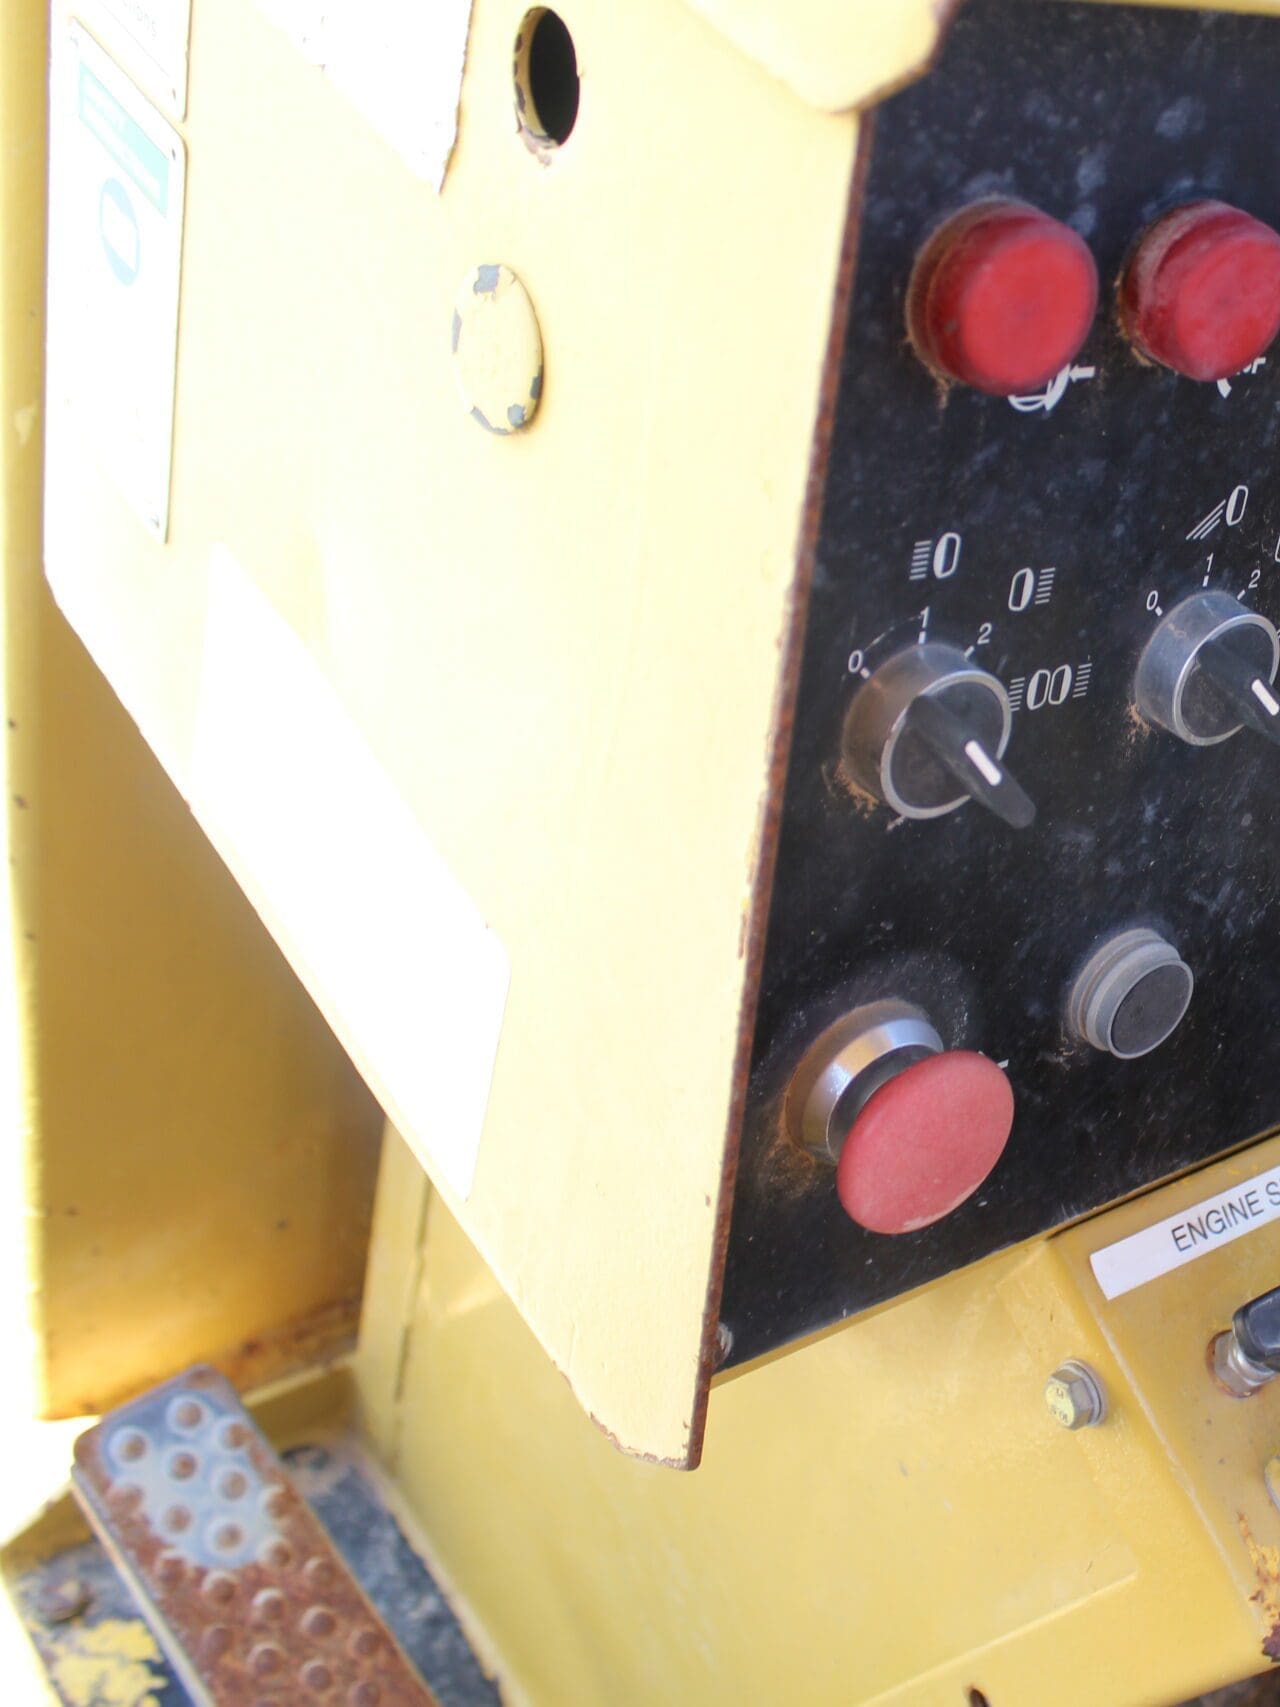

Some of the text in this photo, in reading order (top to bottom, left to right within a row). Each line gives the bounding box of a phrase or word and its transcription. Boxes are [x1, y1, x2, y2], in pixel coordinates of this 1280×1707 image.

[1206, 552, 1214, 573] 1
[1248, 569, 1261, 589] 2
[920, 606, 930, 628] 1
[977, 622, 992, 645] 2
[1171, 1190, 1265, 1252] ENGINE
